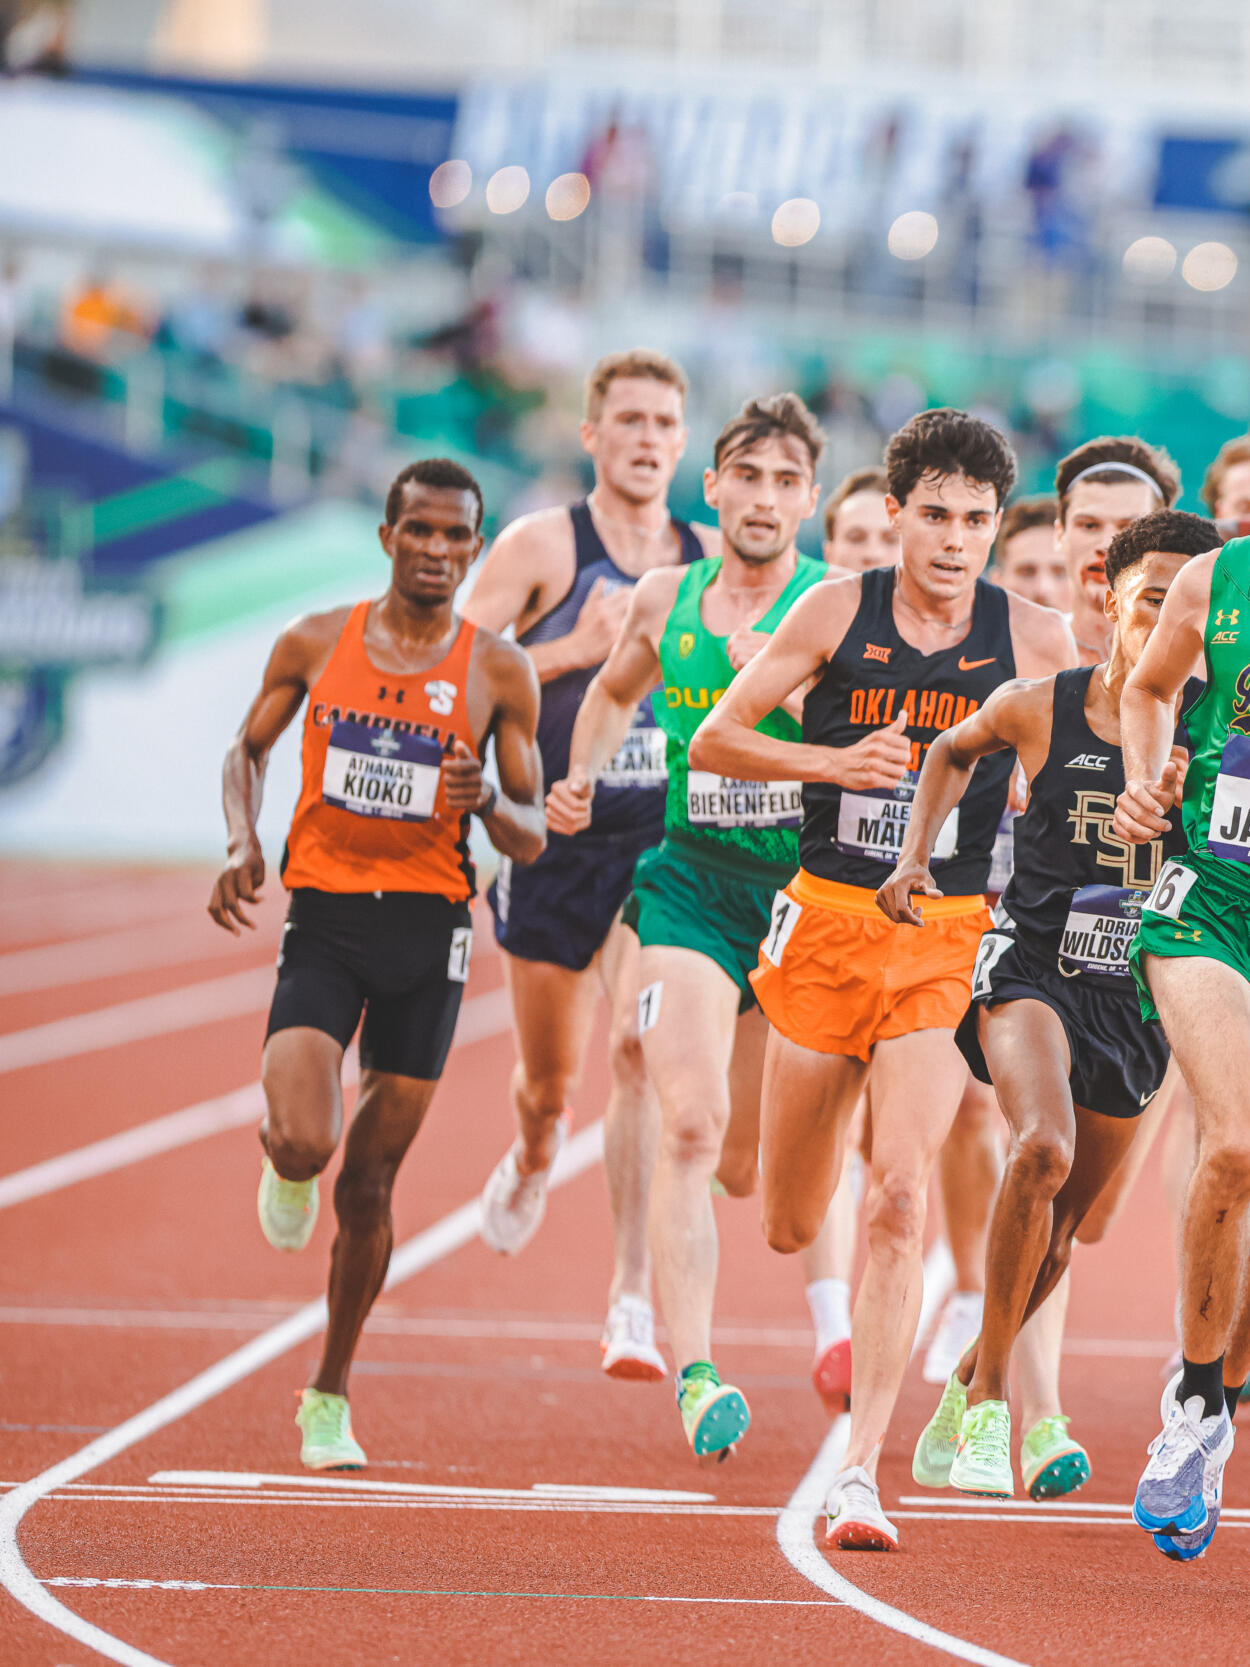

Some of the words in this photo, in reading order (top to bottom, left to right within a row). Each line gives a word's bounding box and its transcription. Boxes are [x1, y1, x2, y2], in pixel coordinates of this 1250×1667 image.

[1211, 631, 1240, 642] ACC
[349, 757, 414, 780] ATHANAS
[1066, 753, 1111, 769] ACC
[343, 774, 413, 806] KIOKO
[690, 792, 801, 816] BIENENFELD
[881, 803, 912, 820] ALE
[1093, 918, 1140, 936] ADRIA
